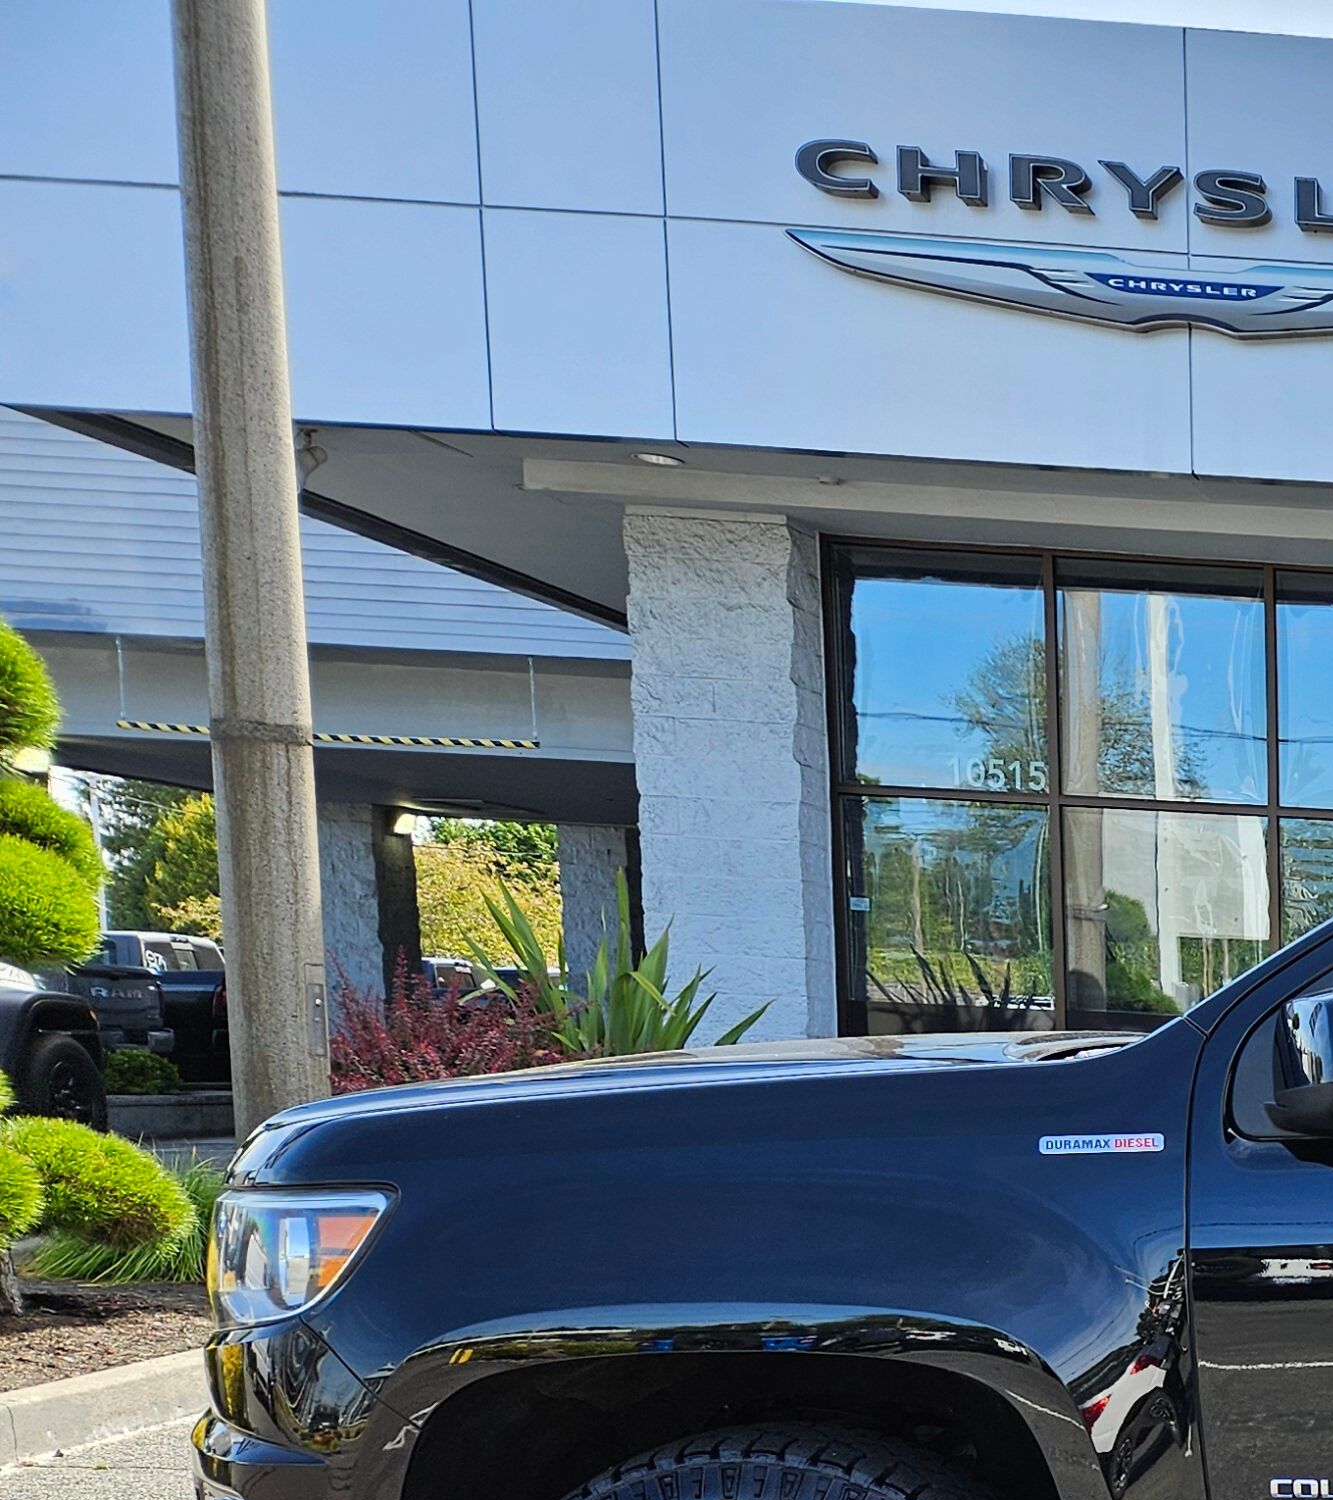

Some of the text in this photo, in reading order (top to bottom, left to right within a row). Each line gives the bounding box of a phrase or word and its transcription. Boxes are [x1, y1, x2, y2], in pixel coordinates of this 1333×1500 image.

[1107, 277, 1257, 298] CHRYSLER
[947, 757, 1047, 792] 10515
[89, 986, 142, 999] RAM
[1045, 1137, 1158, 1150] DURAMAX DIESEL
